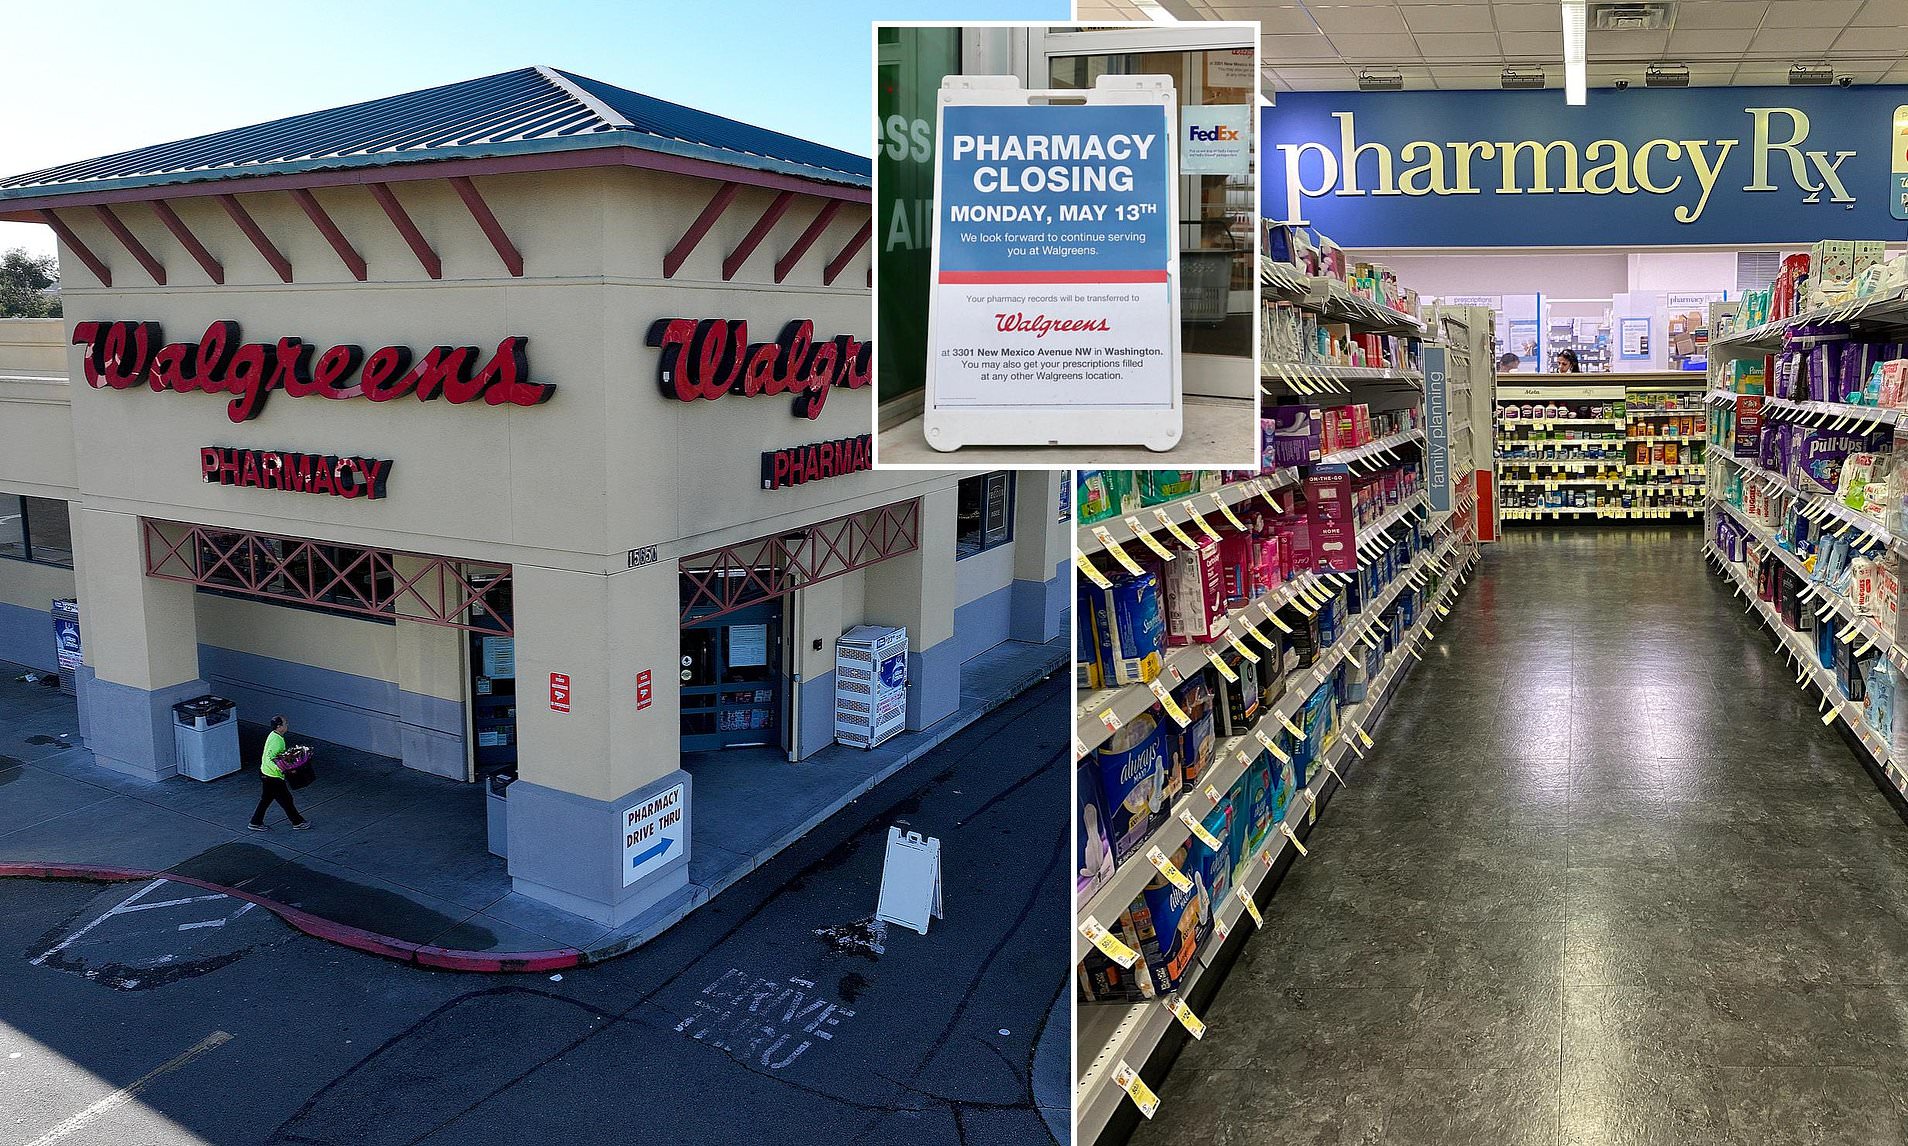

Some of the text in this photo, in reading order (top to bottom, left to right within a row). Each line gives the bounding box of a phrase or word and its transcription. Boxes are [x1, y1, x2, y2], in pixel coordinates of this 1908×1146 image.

[878, 114, 931, 163] ss
[1189, 125, 1239, 141] FedEx
[953, 135, 1156, 161] PHARMACY
[973, 166, 1134, 192] CLOSING
[1276, 107, 1857, 226] pharmacy Rx
[951, 204, 1157, 224] MONDAY, MAY 13TH
[960, 232, 1146, 244] We look forward to continue serving
[1007, 246, 1099, 257] you at Walgreens.
[966, 295, 985, 303] Your
[987, 295, 1026, 305] pharmacy
[1027, 295, 1058, 303] records
[1060, 294, 1073, 302] will
[1074, 294, 1085, 302] be
[1087, 294, 1130, 302] transferred
[1670, 296, 1704, 305] pharmacy
[995, 312, 1111, 339] Walgreens
[941, 347, 1164, 358] at 3301 New Mexico Avenue NW in Washington.
[961, 358, 1144, 371] You may also get your prescriptions filled
[72, 320, 557, 424] Walgreens
[646, 318, 872, 420] Walgr
[980, 370, 1124, 383] at any other Walgreens location.
[1429, 371, 1447, 489] family planning
[200, 446, 394, 500] PHARMACY
[1120, 738, 1159, 785] always
[628, 788, 680, 827] PHARMACY
[626, 807, 681, 849] DRIVE THRU
